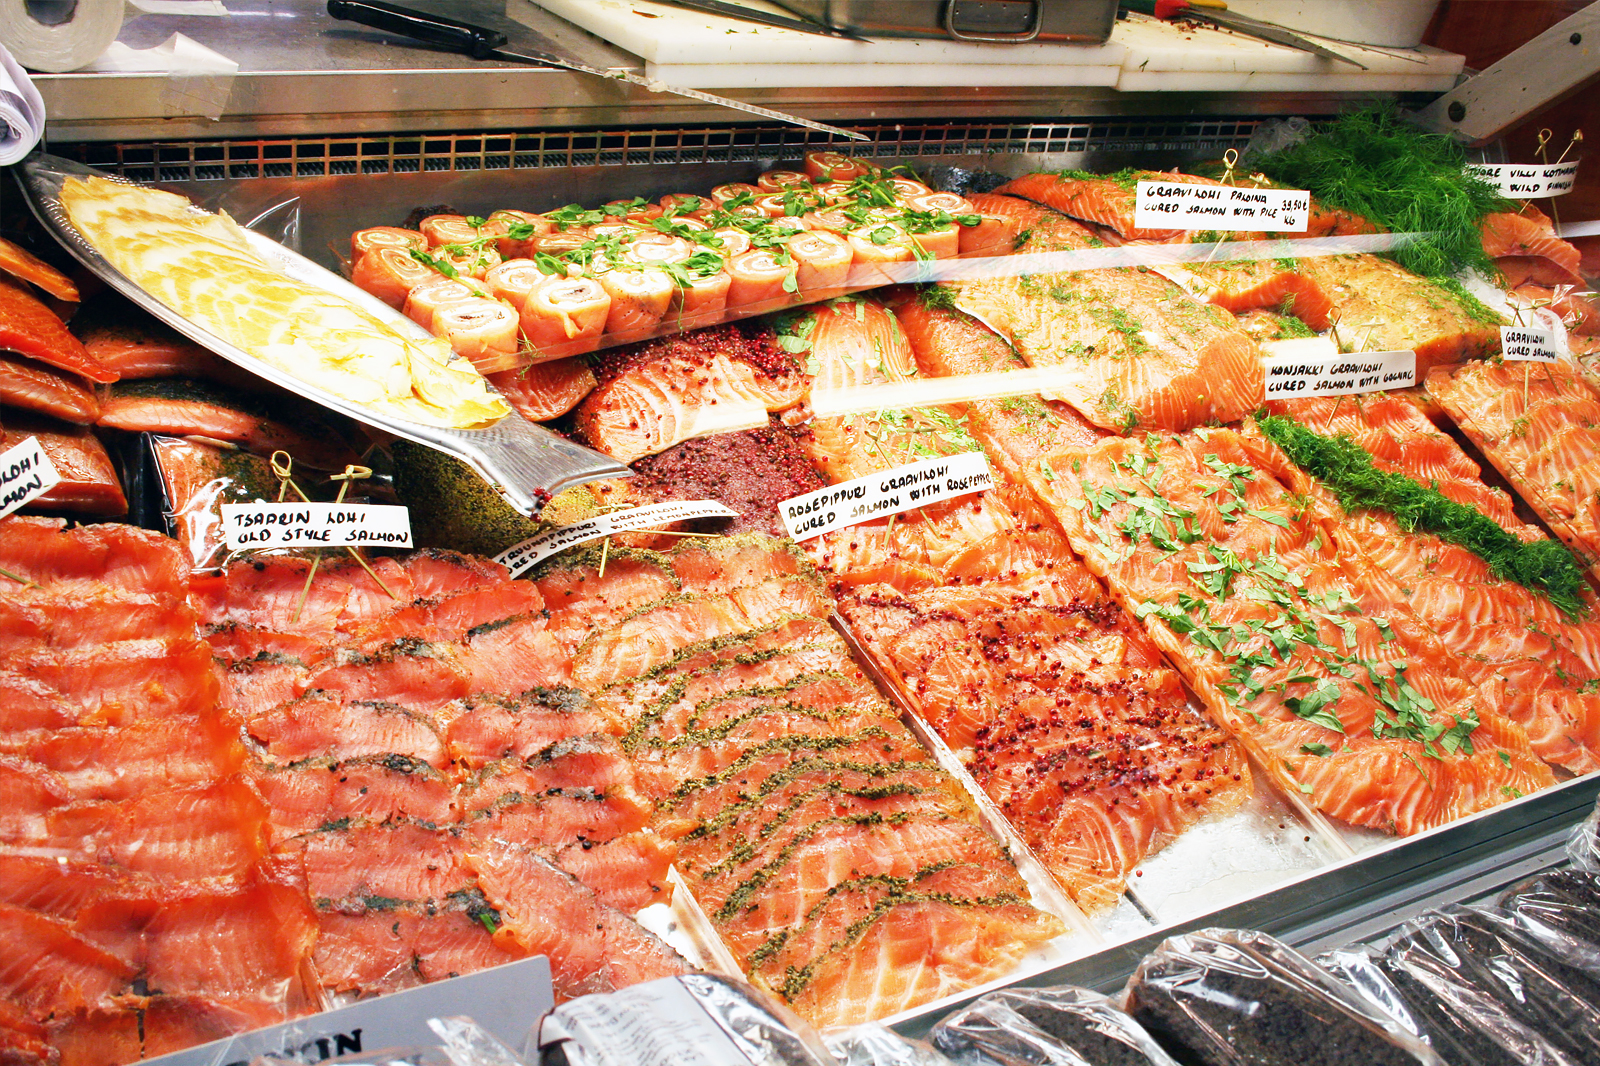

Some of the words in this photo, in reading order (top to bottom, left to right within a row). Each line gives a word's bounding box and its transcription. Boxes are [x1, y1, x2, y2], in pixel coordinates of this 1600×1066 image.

[1510, 169, 1536, 178] VILLI
[1510, 183, 1541, 193] WILD
[1144, 202, 1179, 213] CURED
[1185, 205, 1227, 216] SALMON
[1233, 207, 1255, 218] WITH
[1284, 214, 1296, 226] KG
[1507, 346, 1530, 356] CURED
[1532, 347, 1556, 360] SALMON
[1270, 364, 1324, 376] KONJAKKI
[1268, 379, 1306, 392] CURED
[1313, 378, 1354, 391] SALMON
[1359, 375, 1379, 388] WITH
[0, 452, 39, 488] LOHI
[788, 485, 866, 519] ROSEPIPPURI
[880, 465, 949, 493] GRAAVILOHI
[794, 511, 836, 535] CURED
[850, 495, 900, 518] SALMON
[909, 485, 940, 501] WITH
[234, 510, 311, 527] TSAARIN
[326, 511, 366, 525] LOHI
[238, 528, 272, 544] OLD
[282, 528, 332, 542] STYLE
[344, 529, 408, 543] SALMON
[549, 528, 601, 550] SALMON
[610, 519, 647, 531] WITH
[499, 521, 597, 566] TRUUNAPIPPURI
